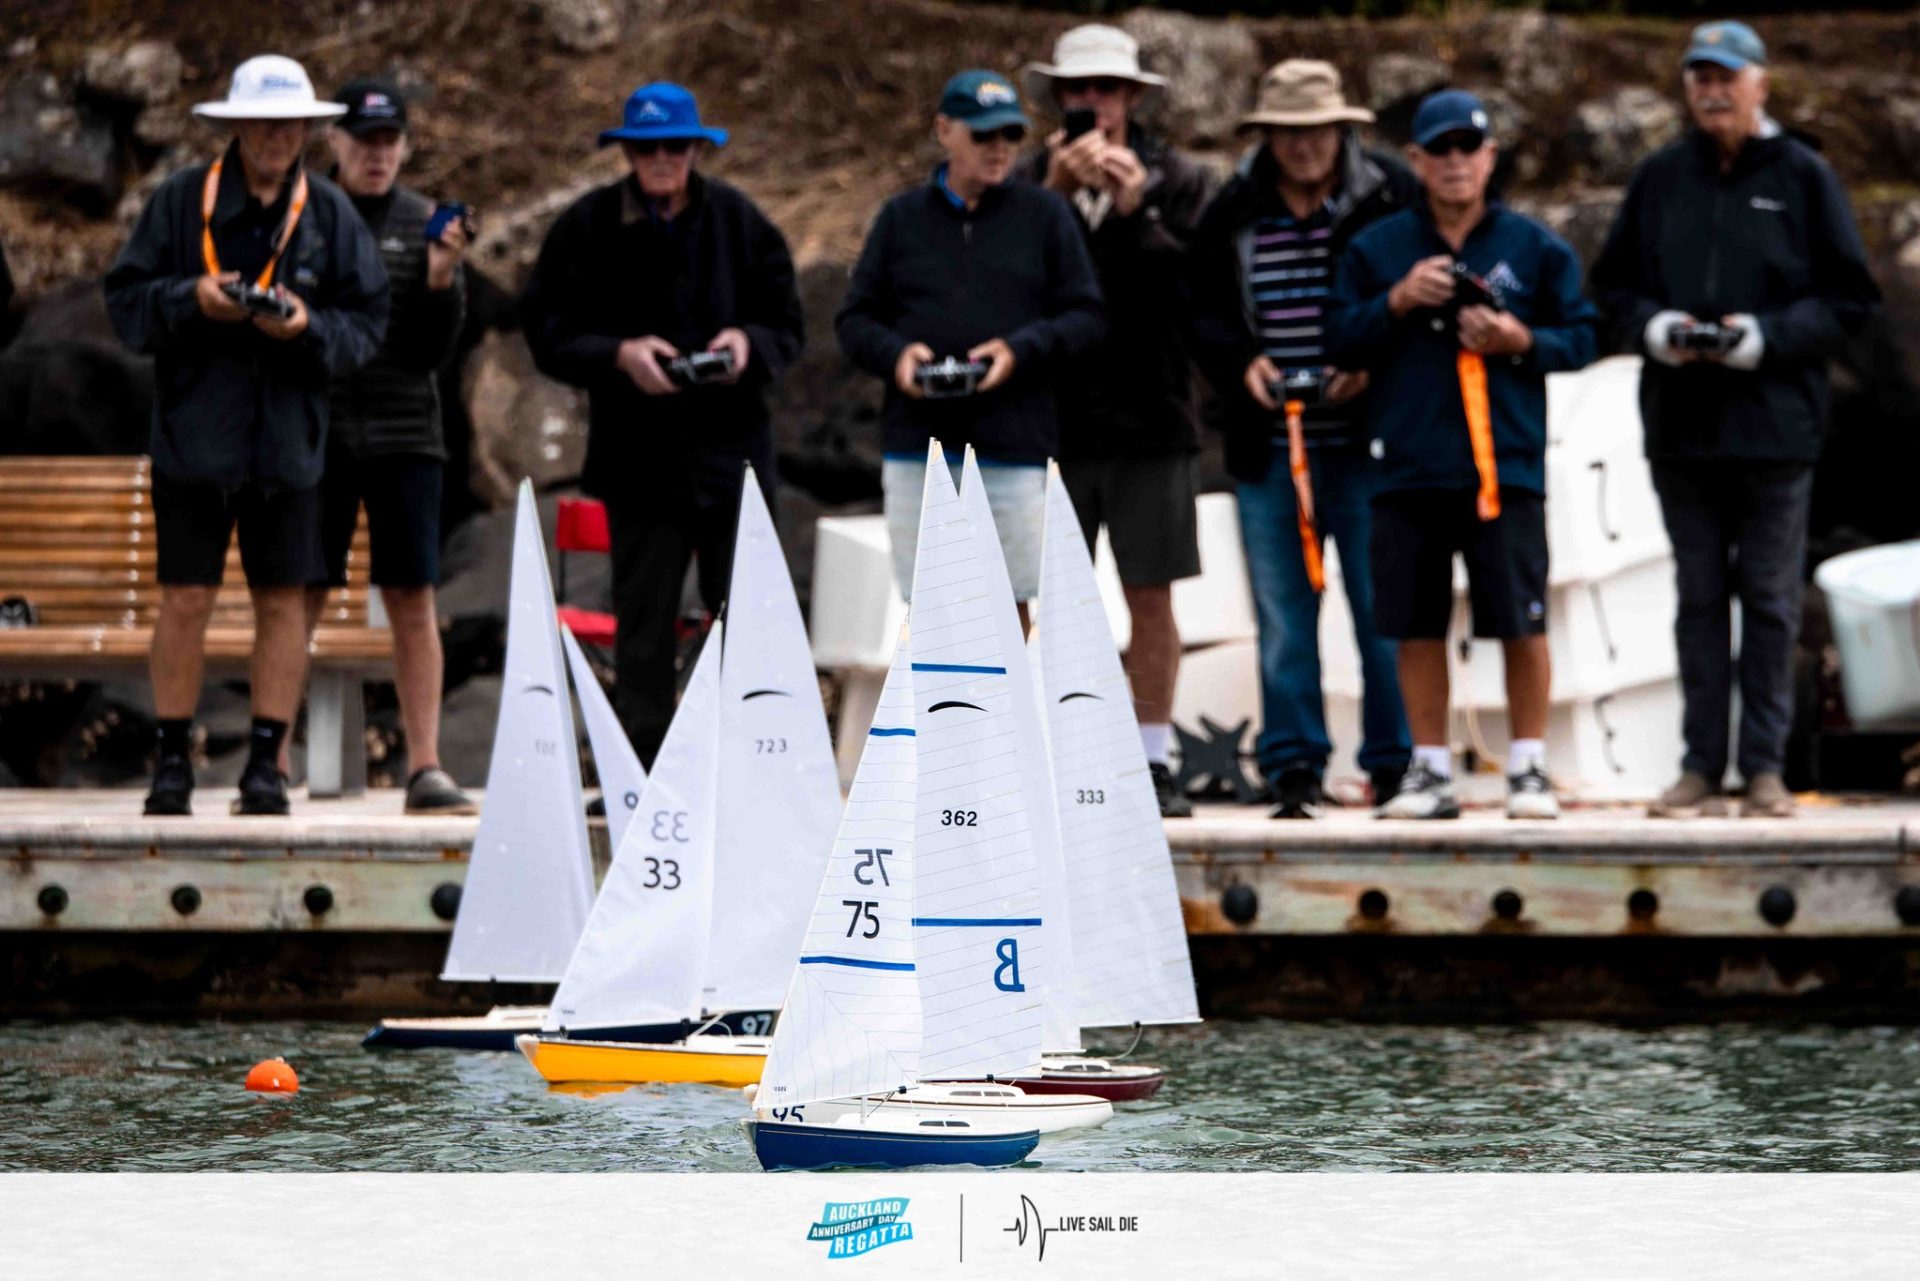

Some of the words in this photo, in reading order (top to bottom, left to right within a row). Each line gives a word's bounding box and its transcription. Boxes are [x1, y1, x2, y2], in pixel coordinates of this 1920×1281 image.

[755, 738, 787, 755] 723
[1076, 789, 1105, 804] 333
[941, 810, 977, 827] 362
[643, 857, 682, 890] 33
[842, 900, 880, 939] 75
[742, 1013, 772, 1036] 97
